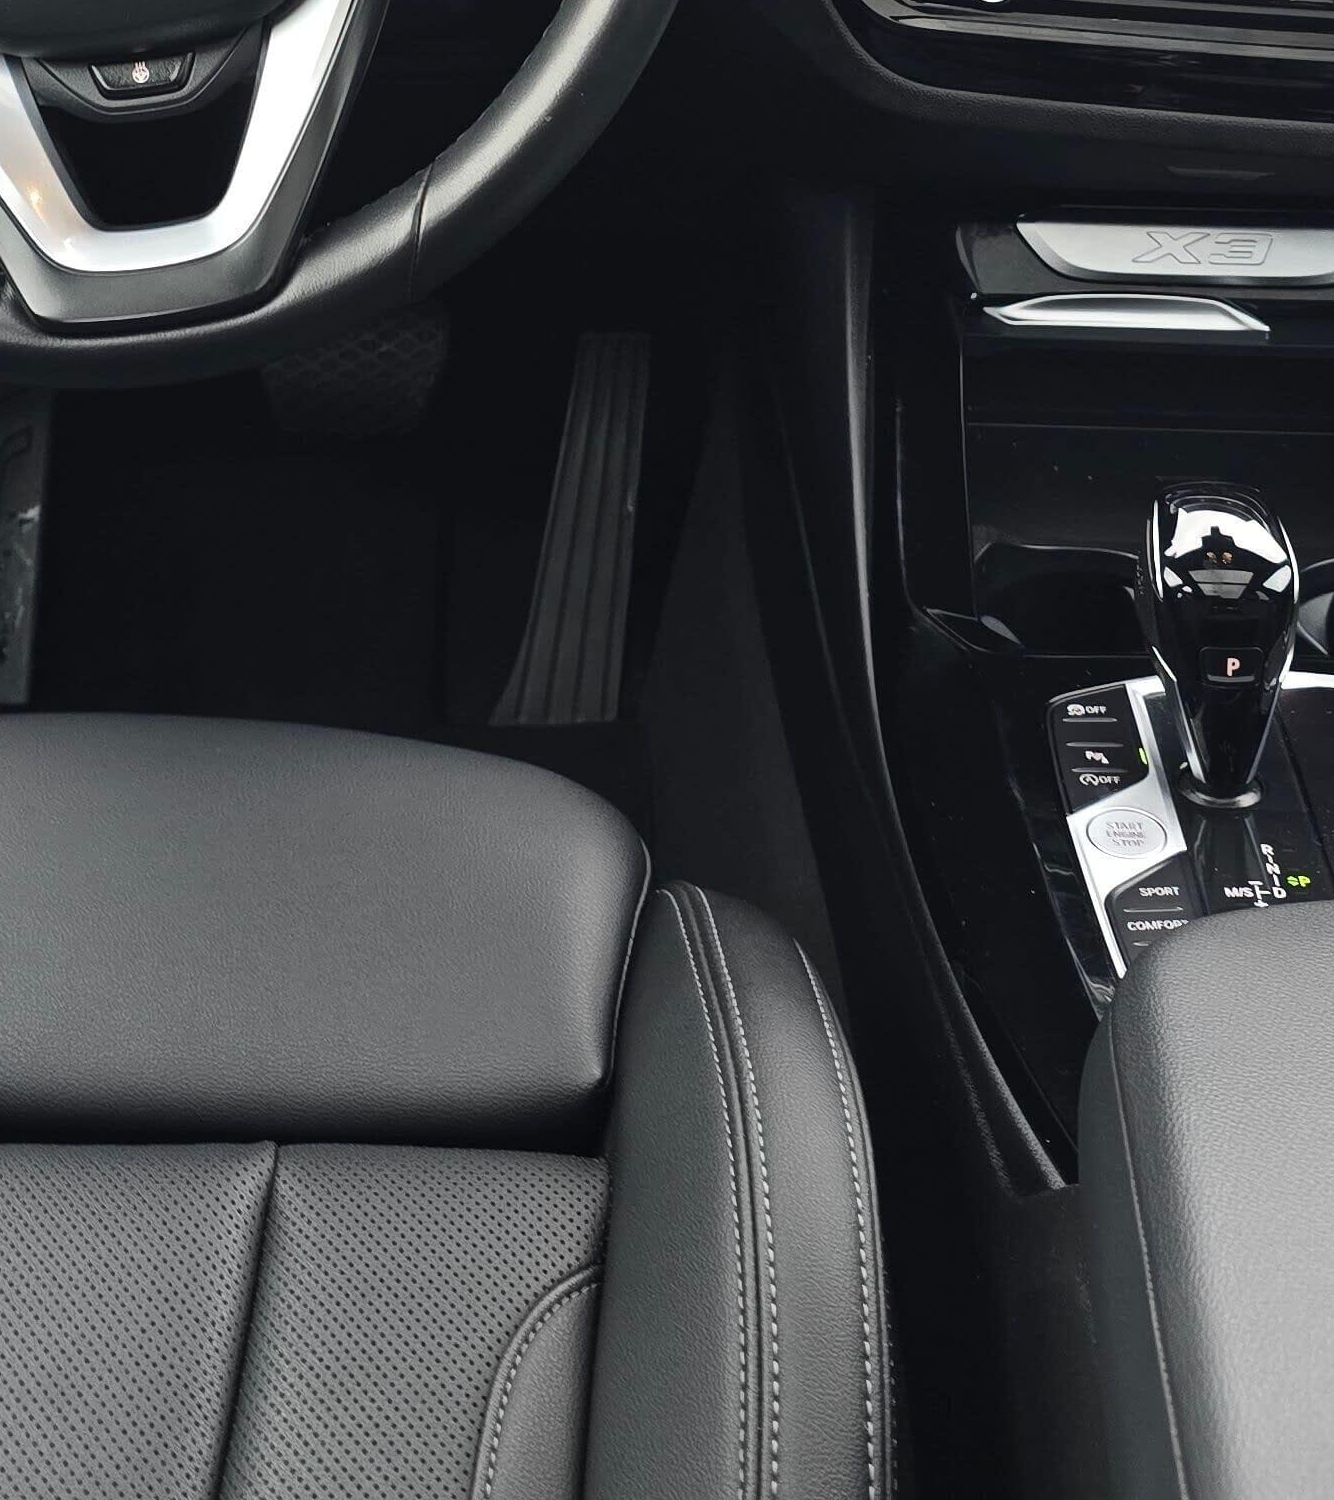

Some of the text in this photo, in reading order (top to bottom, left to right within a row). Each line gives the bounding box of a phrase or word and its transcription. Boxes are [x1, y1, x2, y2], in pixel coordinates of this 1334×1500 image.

[1131, 230, 1274, 266] X3
[1226, 657, 1240, 677] P
[1085, 704, 1107, 715] OFF
[1098, 774, 1121, 785] OFF
[1106, 821, 1144, 830] START
[1105, 830, 1146, 839] ENGINE
[1111, 838, 1145, 848] STOP
[1260, 843, 1275, 856] R
[1265, 862, 1281, 875] N
[1138, 886, 1180, 898] SPORT
[1272, 886, 1287, 899] D
